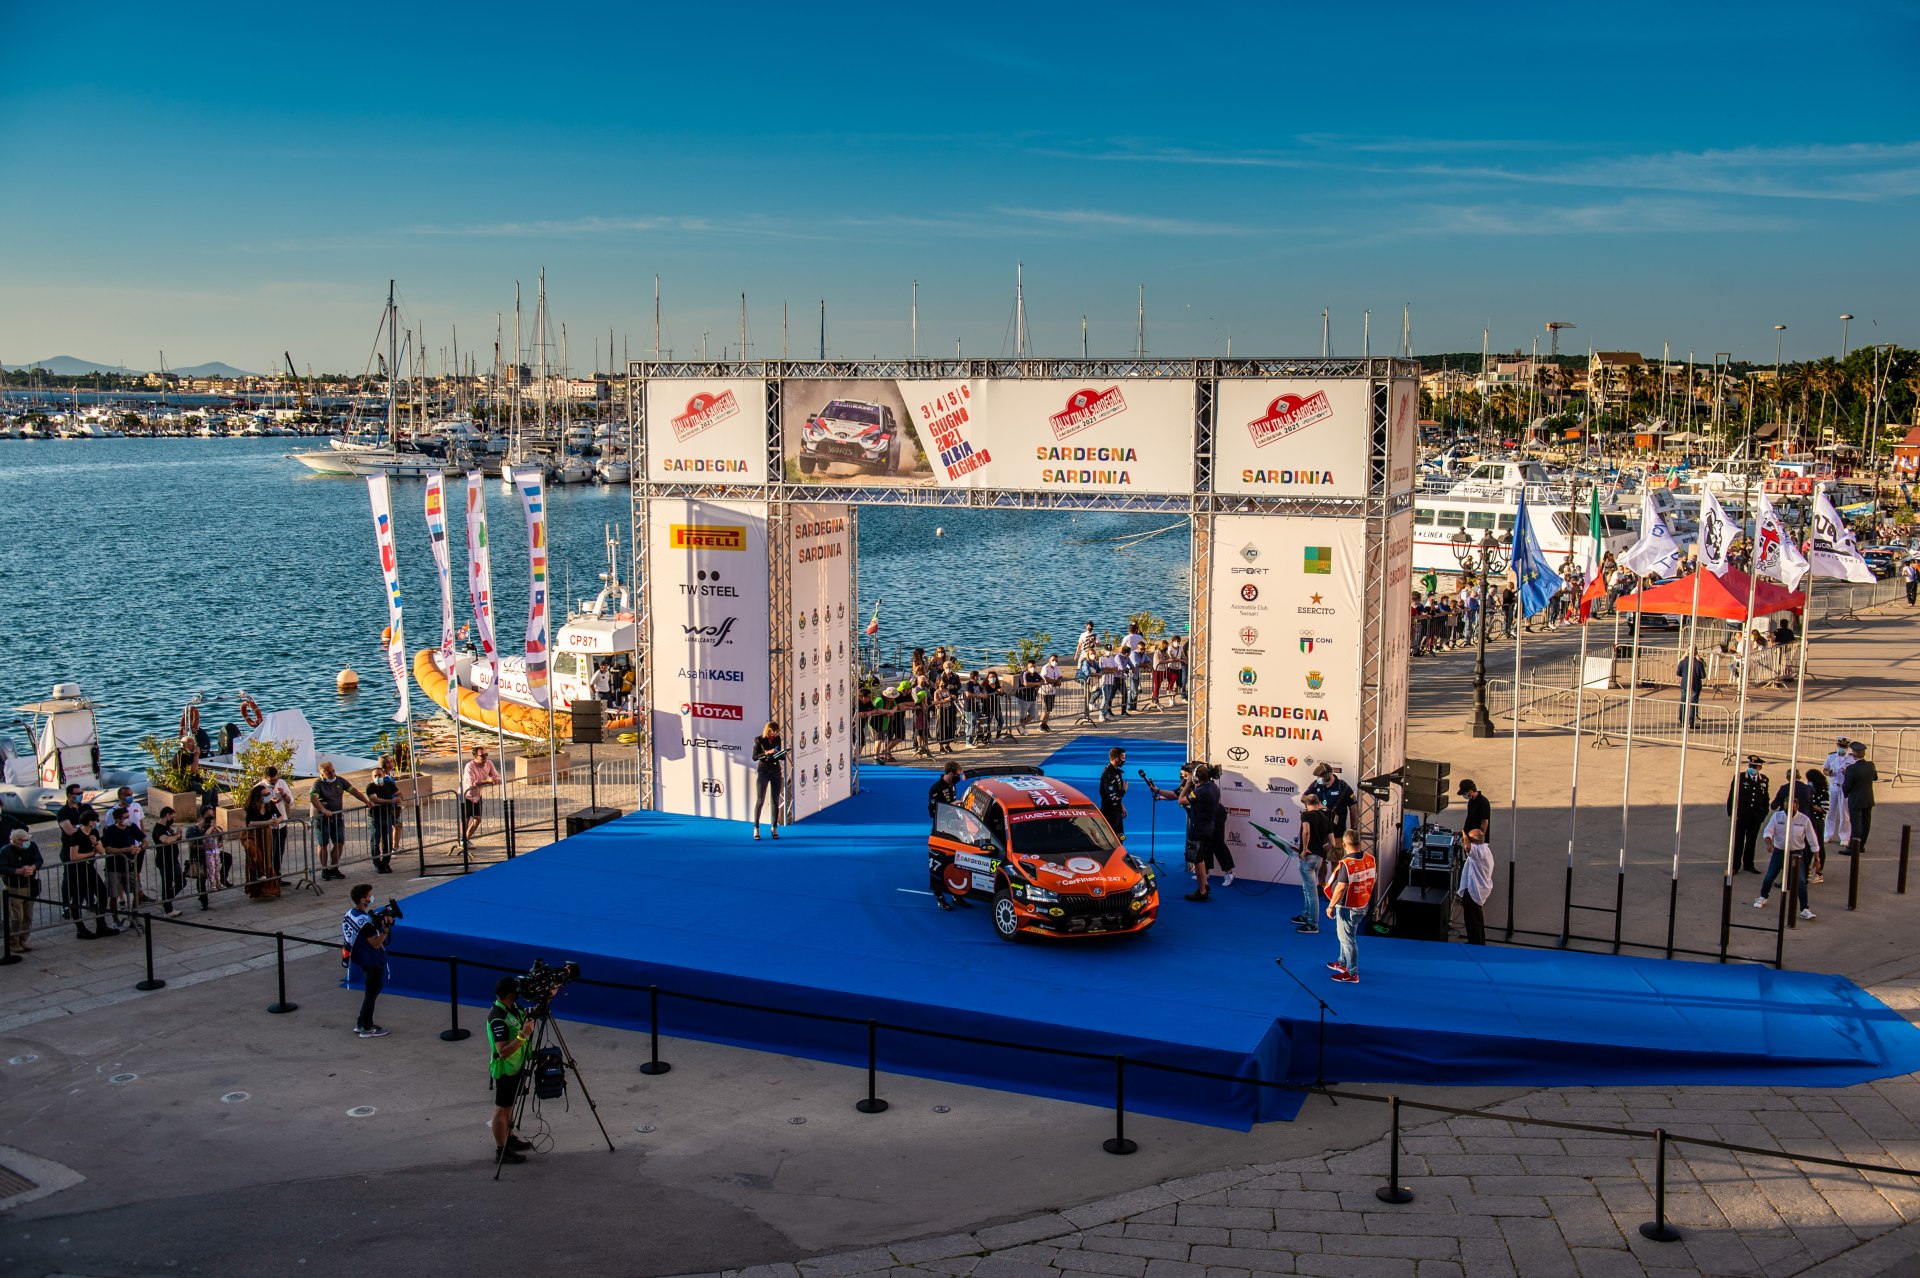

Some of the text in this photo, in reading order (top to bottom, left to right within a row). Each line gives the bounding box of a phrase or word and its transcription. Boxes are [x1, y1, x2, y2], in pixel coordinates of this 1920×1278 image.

[673, 415, 692, 436] RALLY
[690, 410, 708, 429] ITALIA
[706, 392, 735, 419] SARDEGNA
[1050, 411, 1074, 432] RALLY
[1071, 407, 1090, 426] ITALIA
[1090, 388, 1122, 416] SARDEGNA
[1249, 418, 1274, 440] RALLY
[1272, 414, 1294, 432] ITALIA
[1292, 394, 1328, 422] SARDEGNA
[701, 419, 714, 429] 2021
[928, 407, 969, 438] GIUGNO
[1082, 416, 1096, 427] 2021
[1284, 423, 1300, 434] 2021
[935, 428, 964, 452] 2021
[828, 446, 854, 456] YARIS
[940, 441, 974, 468] OLBIA
[1036, 447, 1138, 462] SARDEGNA
[664, 459, 748, 472] SARDEGNA
[946, 448, 992, 481] ALGHERO
[796, 518, 844, 540] SARDEGNA
[677, 529, 740, 547] PIRELLI
[799, 542, 842, 564] SARDINIA
[679, 584, 740, 598] TW STEEL
[1298, 606, 1336, 614] ESERCITO
[678, 668, 744, 682] AsahiKASEI
[696, 704, 742, 719] TOTAL
[1237, 704, 1329, 721] SARDEGNA
[1264, 756, 1286, 764] sara
[1266, 784, 1294, 792] Marriott
[960, 856, 990, 867] SARDEGNA
[1062, 876, 1106, 886] CarFinance
